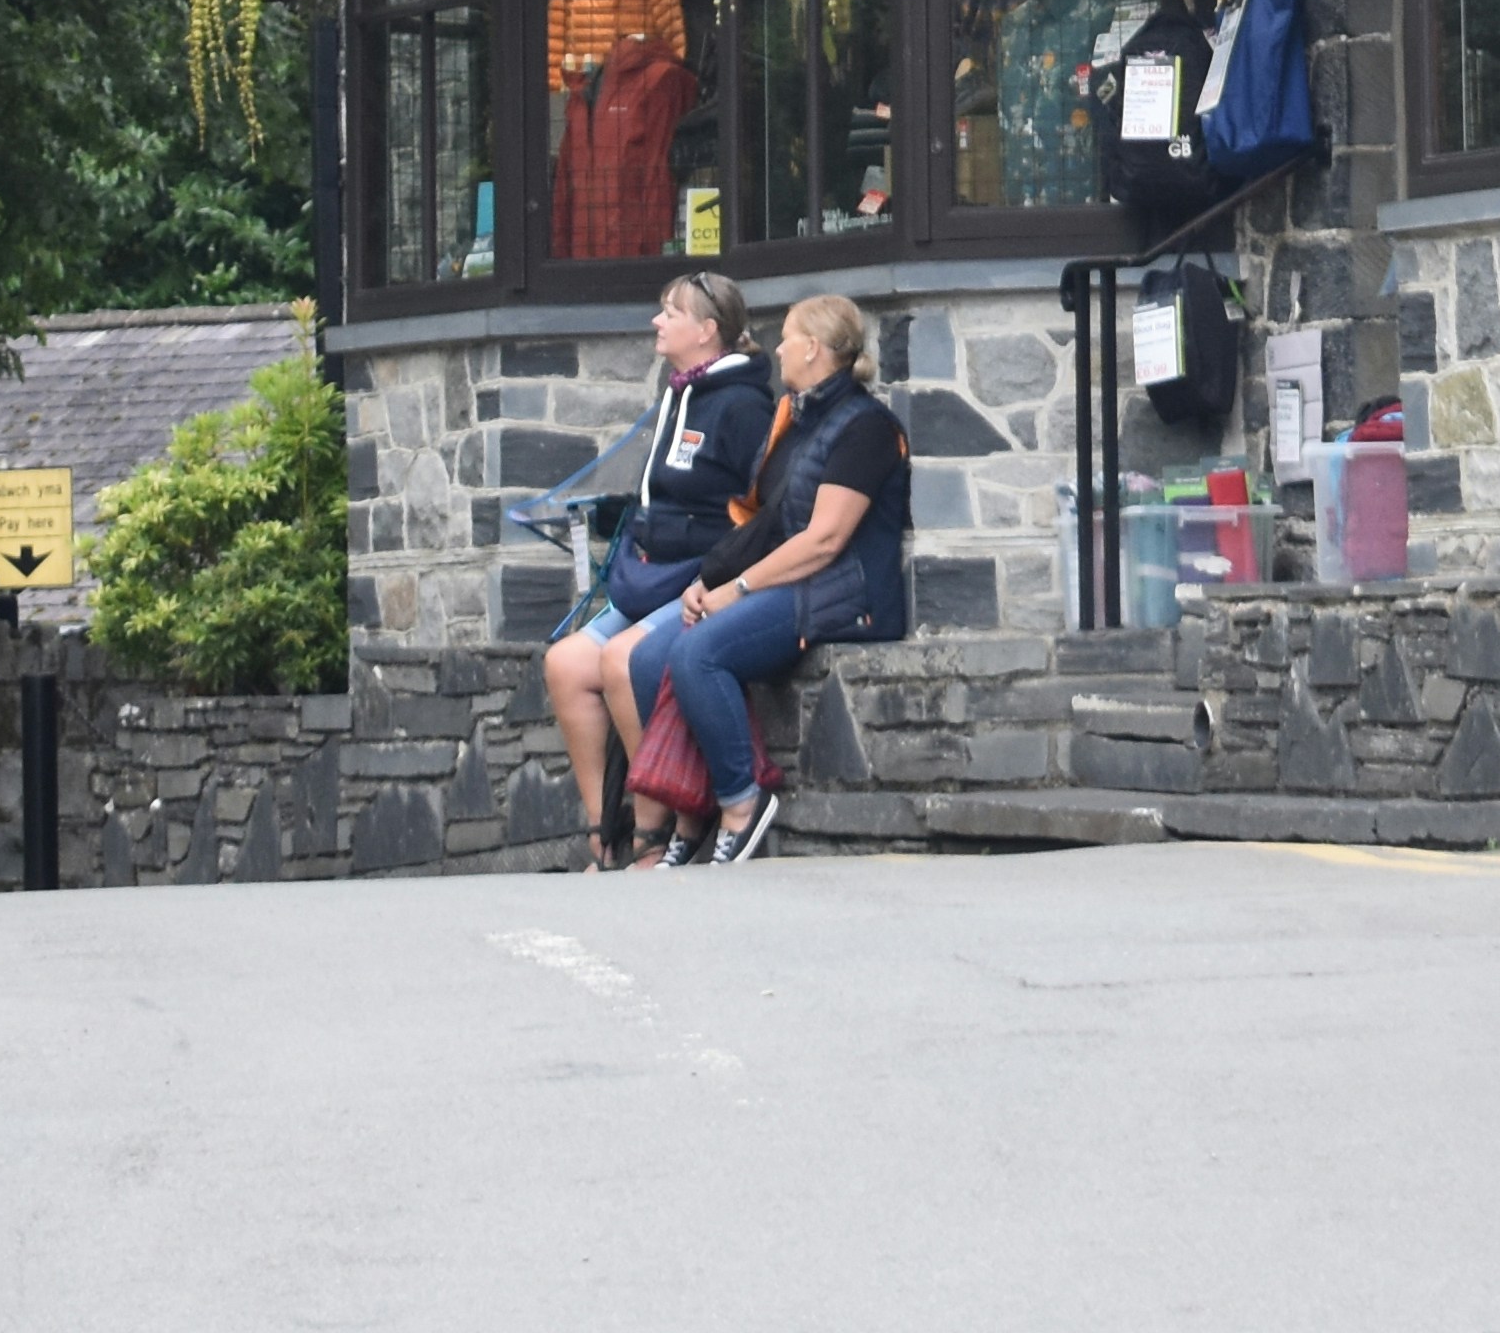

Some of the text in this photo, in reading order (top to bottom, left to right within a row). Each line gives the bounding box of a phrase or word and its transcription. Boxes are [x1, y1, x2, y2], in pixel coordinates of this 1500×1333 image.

[1123, 123, 1163, 134] £15.00
[1168, 142, 1192, 158] GB
[38, 484, 63, 500] yma
[28, 516, 54, 529] here
